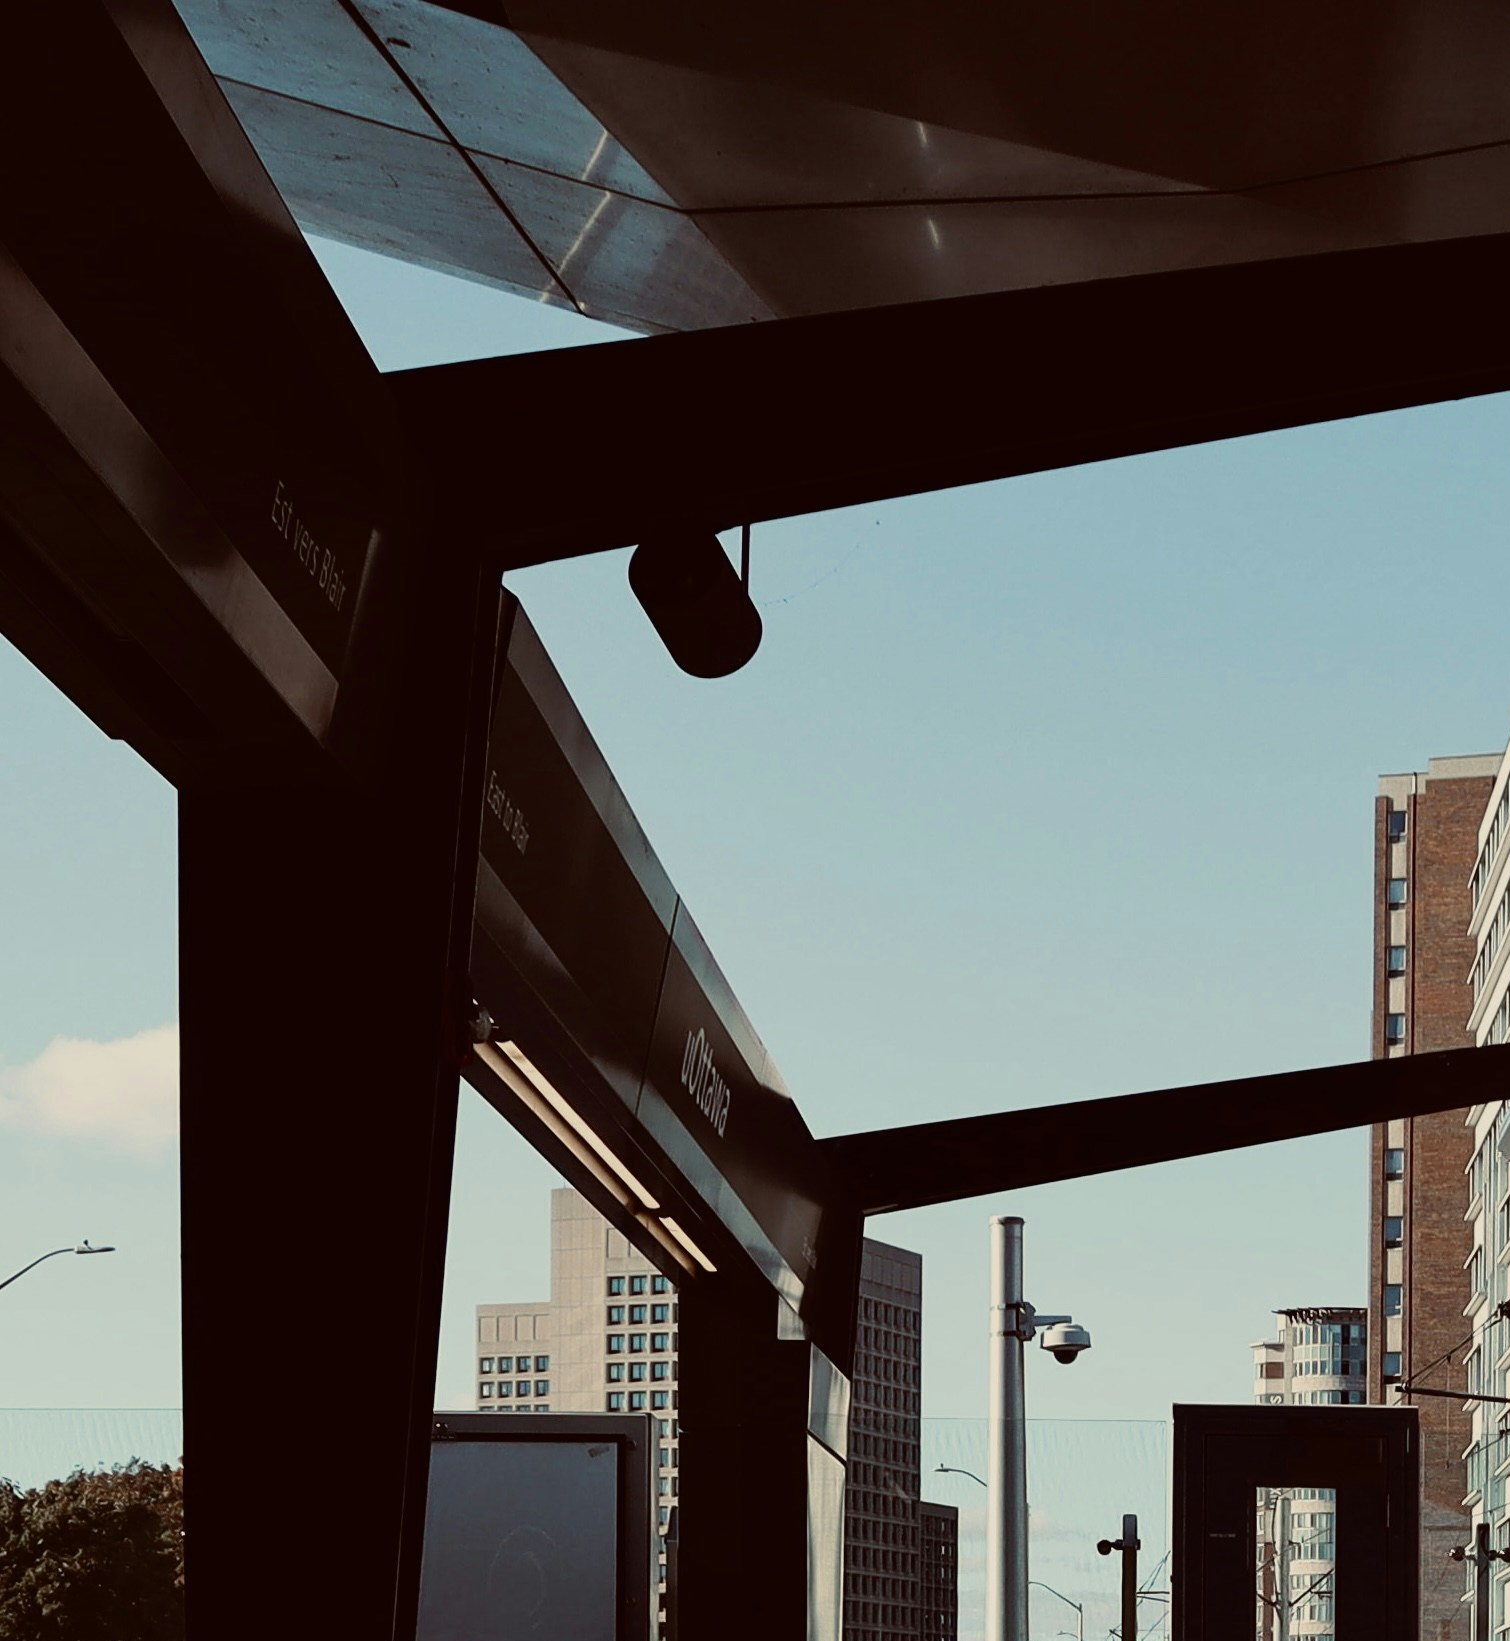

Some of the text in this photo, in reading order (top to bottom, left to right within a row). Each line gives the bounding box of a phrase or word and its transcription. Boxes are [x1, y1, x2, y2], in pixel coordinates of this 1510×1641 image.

[271, 479, 347, 612] Est vers Blair
[486, 769, 506, 819] East
[511, 808, 530, 855] Blair
[681, 1027, 730, 1138] uOttawa
